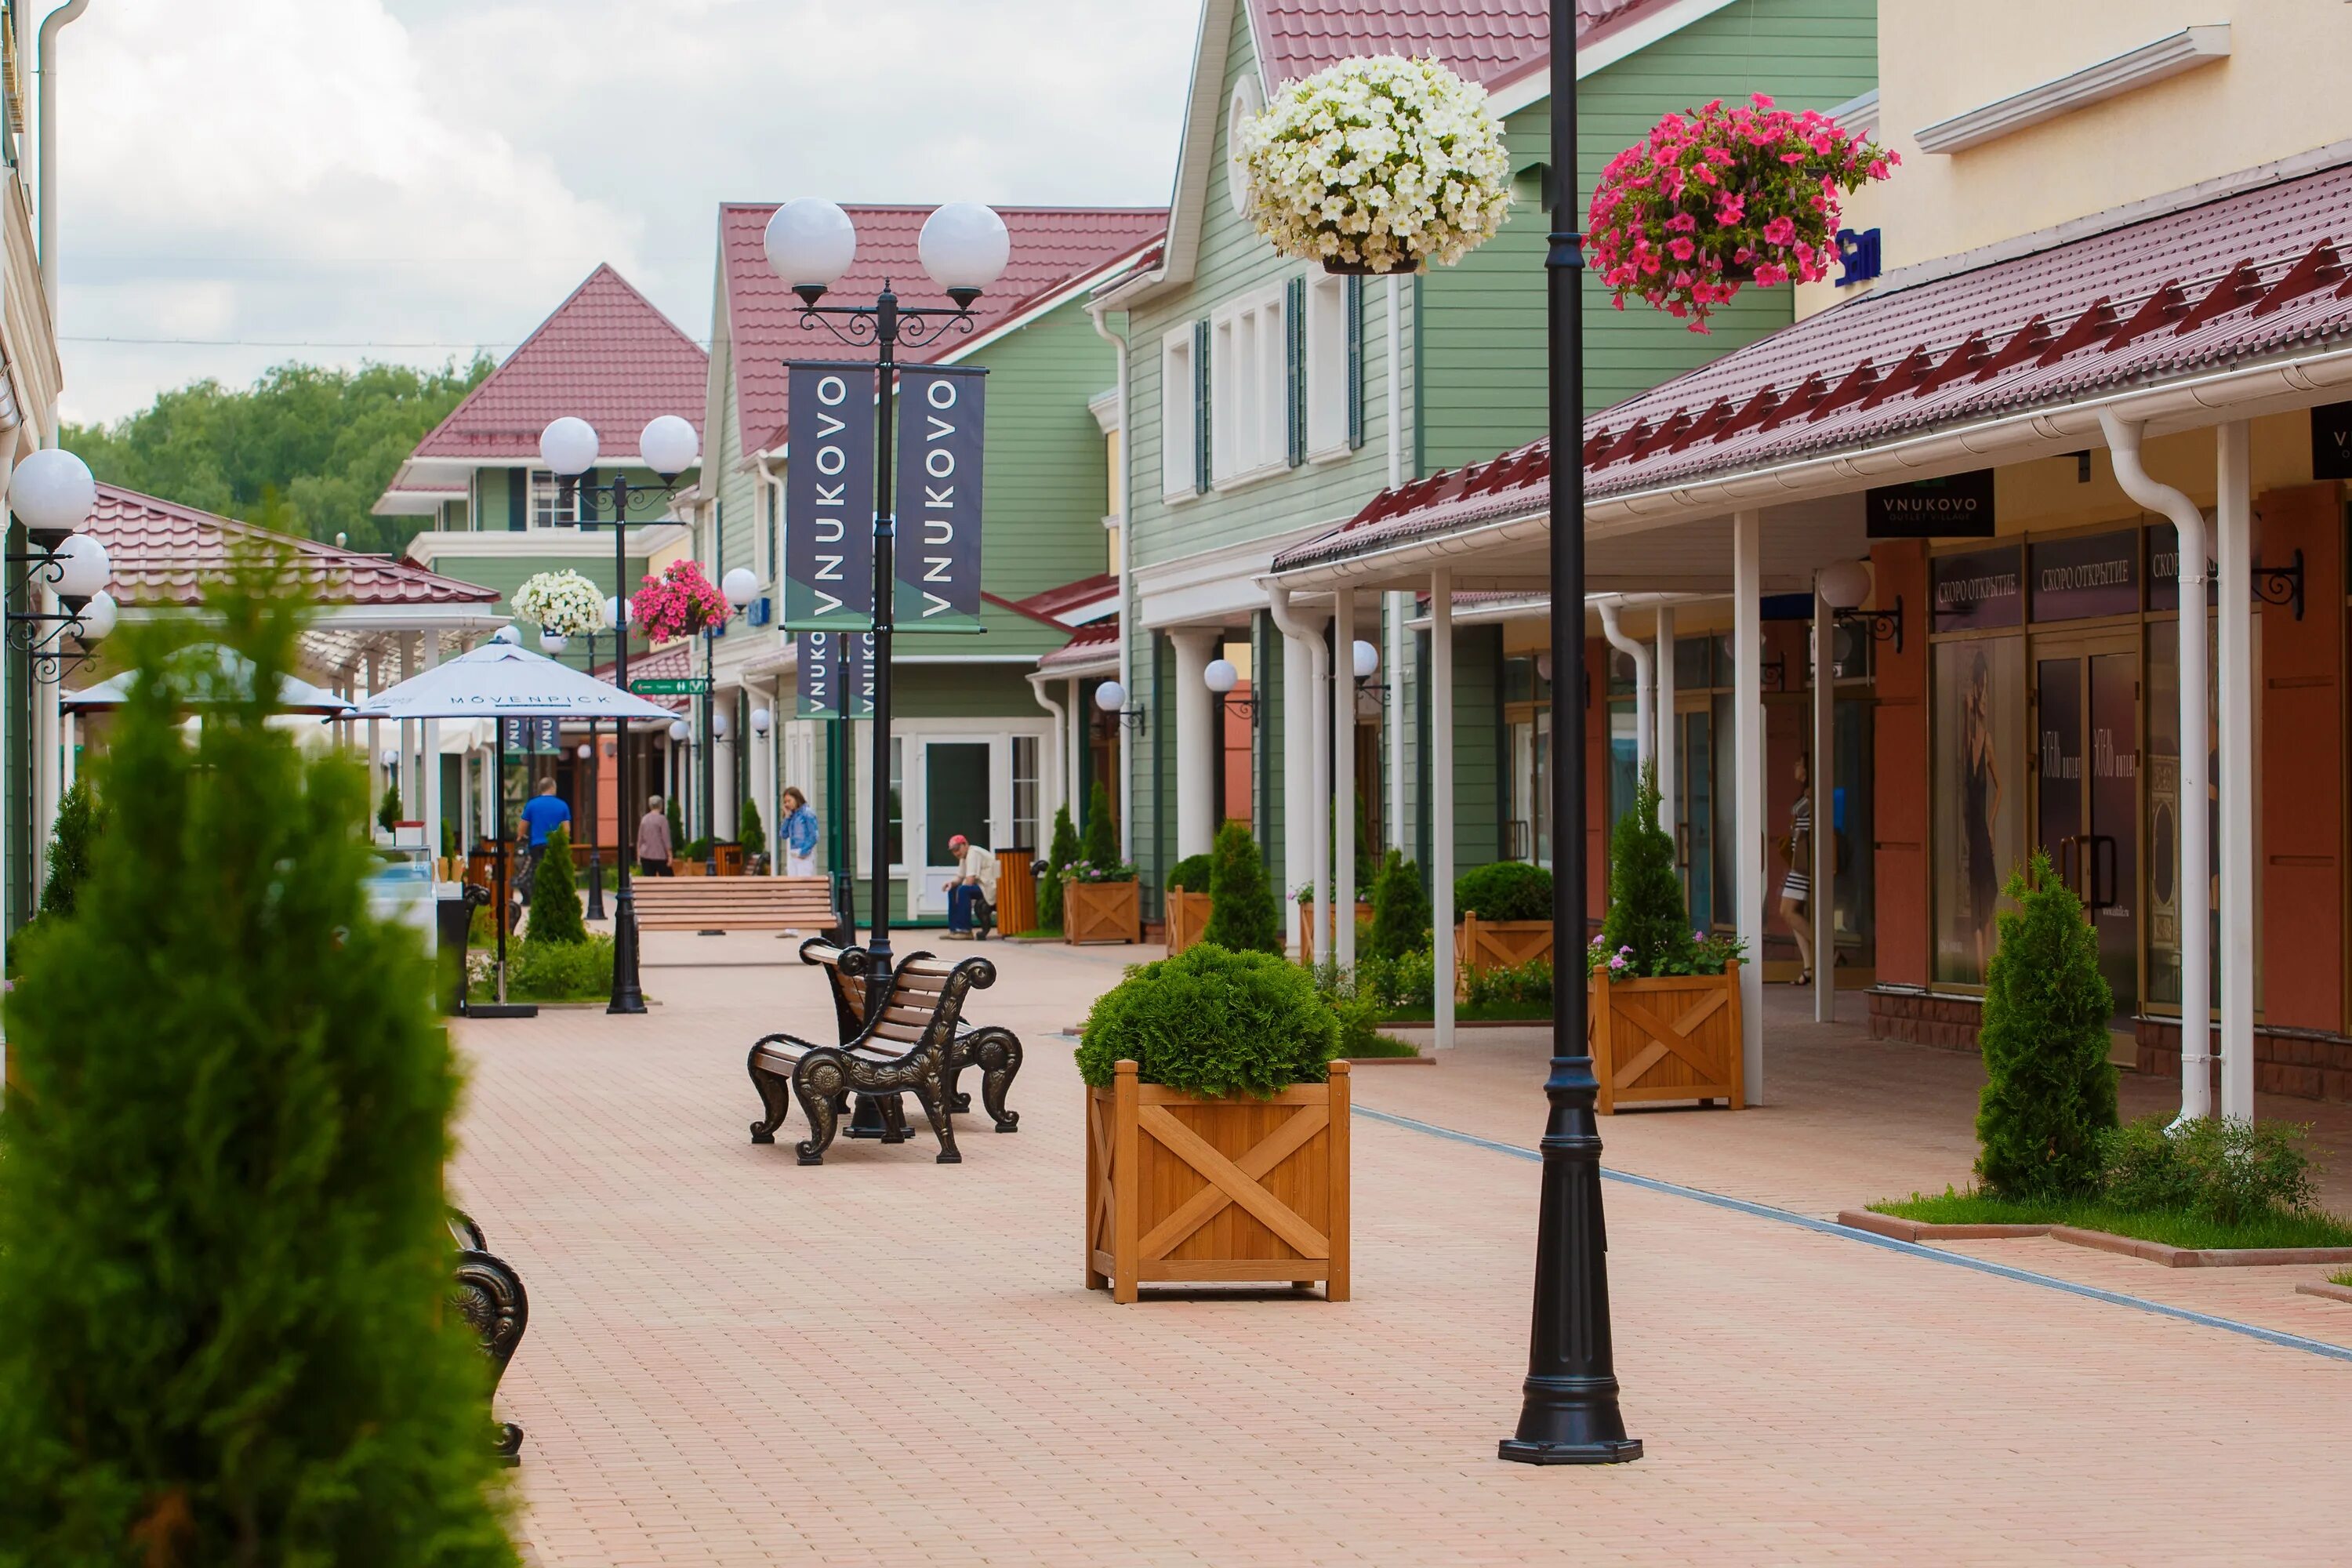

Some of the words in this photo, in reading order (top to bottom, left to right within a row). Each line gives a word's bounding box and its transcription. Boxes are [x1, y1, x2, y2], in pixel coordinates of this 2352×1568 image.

[2333, 431, 2352, 446] V
[814, 376, 847, 616] VNUKOVO
[922, 379, 957, 618] VNUKOVO
[1883, 498, 1977, 511] VNUKOVO
[1889, 513, 1926, 521] OUTLET
[1931, 512, 1971, 521] VILLAGE
[1938, 579, 1967, 603] СКОРО
[1967, 573, 2016, 601] ОТКРЫТИЕ
[2042, 566, 2074, 593] СКОРО
[2074, 559, 2129, 588] ОТКРЫТИЕ
[509, 719, 521, 750] VNU
[542, 719, 554, 750] VNU
